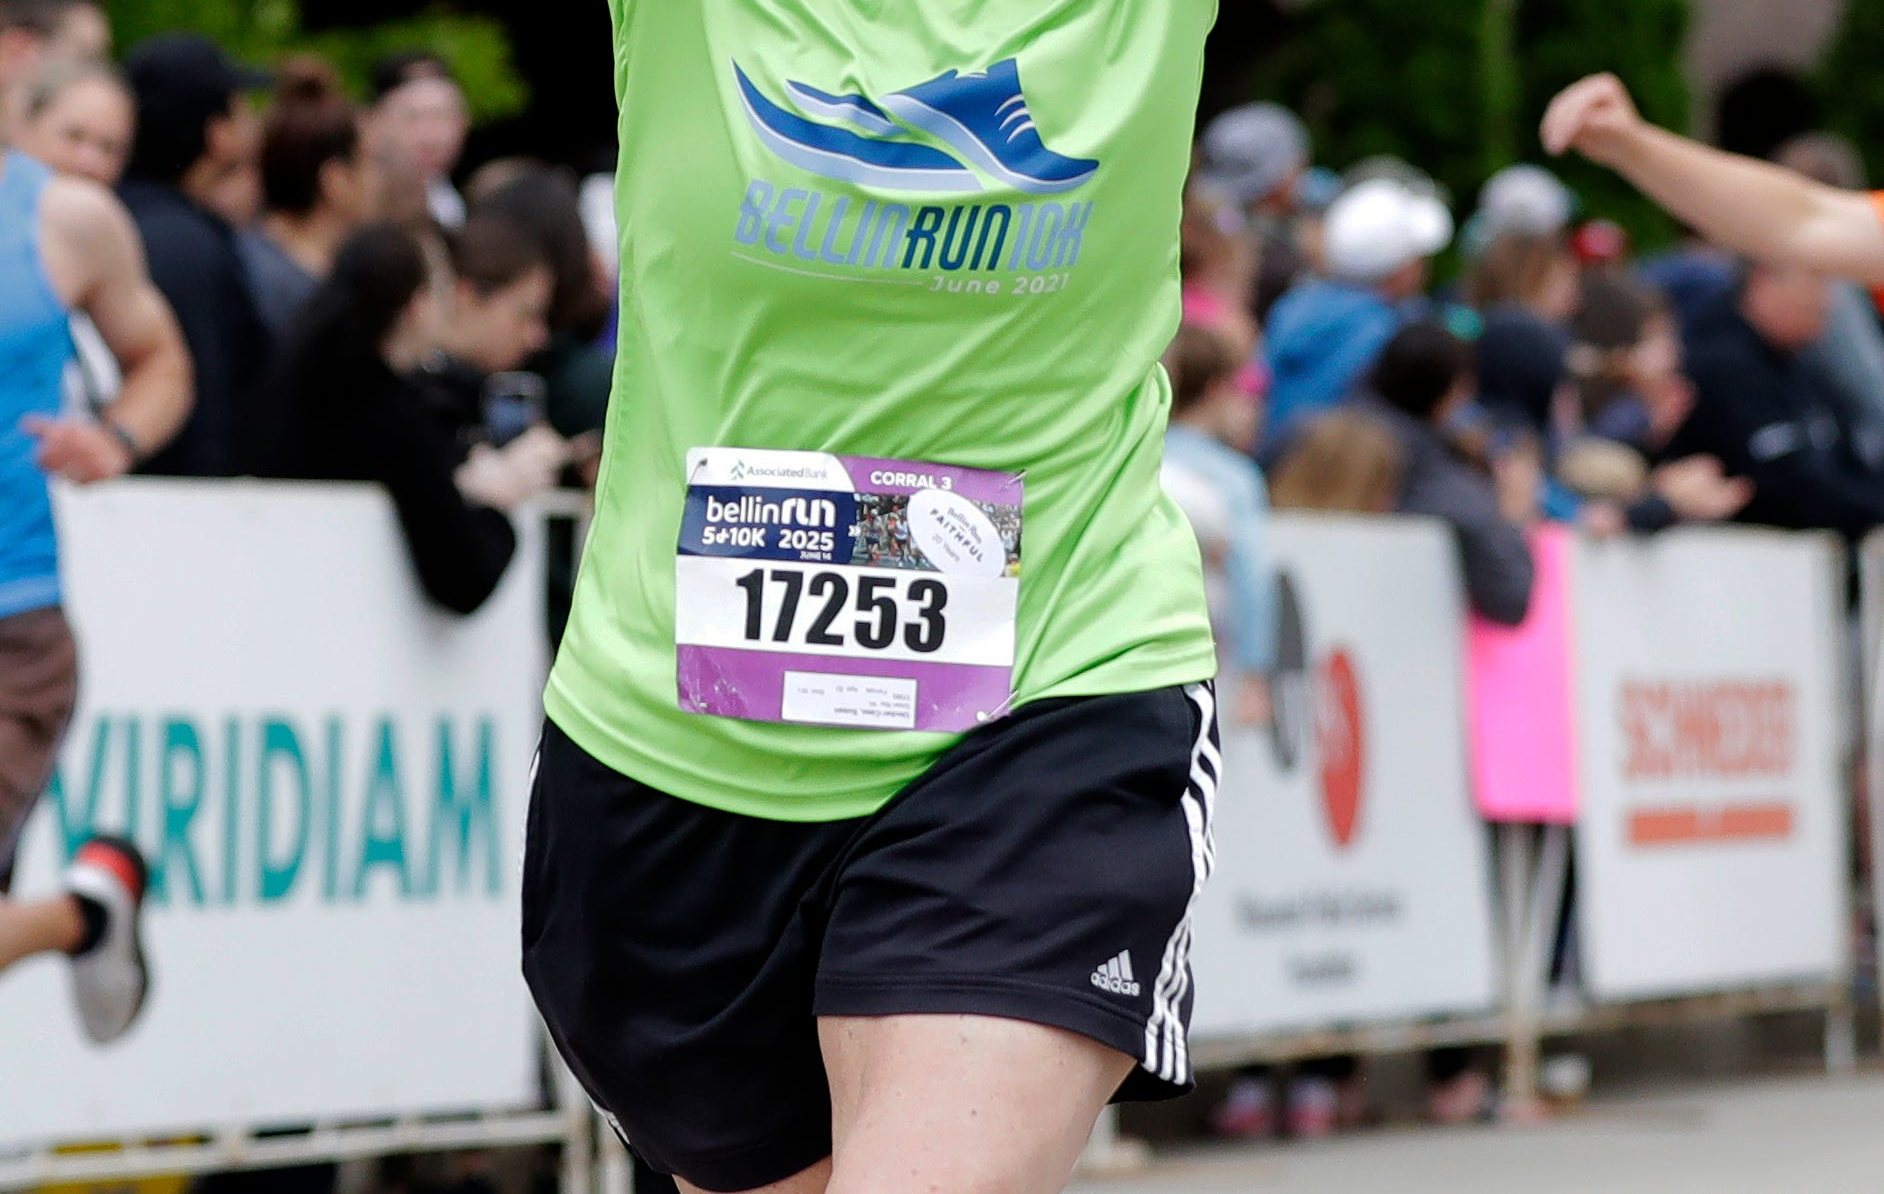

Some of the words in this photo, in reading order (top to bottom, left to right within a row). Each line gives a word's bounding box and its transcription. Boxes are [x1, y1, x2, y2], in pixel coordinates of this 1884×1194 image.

[929, 275, 1001, 295] June
[1011, 272, 1071, 295] 2021
[869, 470, 937, 489] CORRAL
[940, 476, 953, 490] 3
[778, 528, 835, 552] 2025
[929, 508, 984, 563] FAITHFUL
[735, 568, 949, 653] 17253
[1090, 971, 1140, 997] adidas
